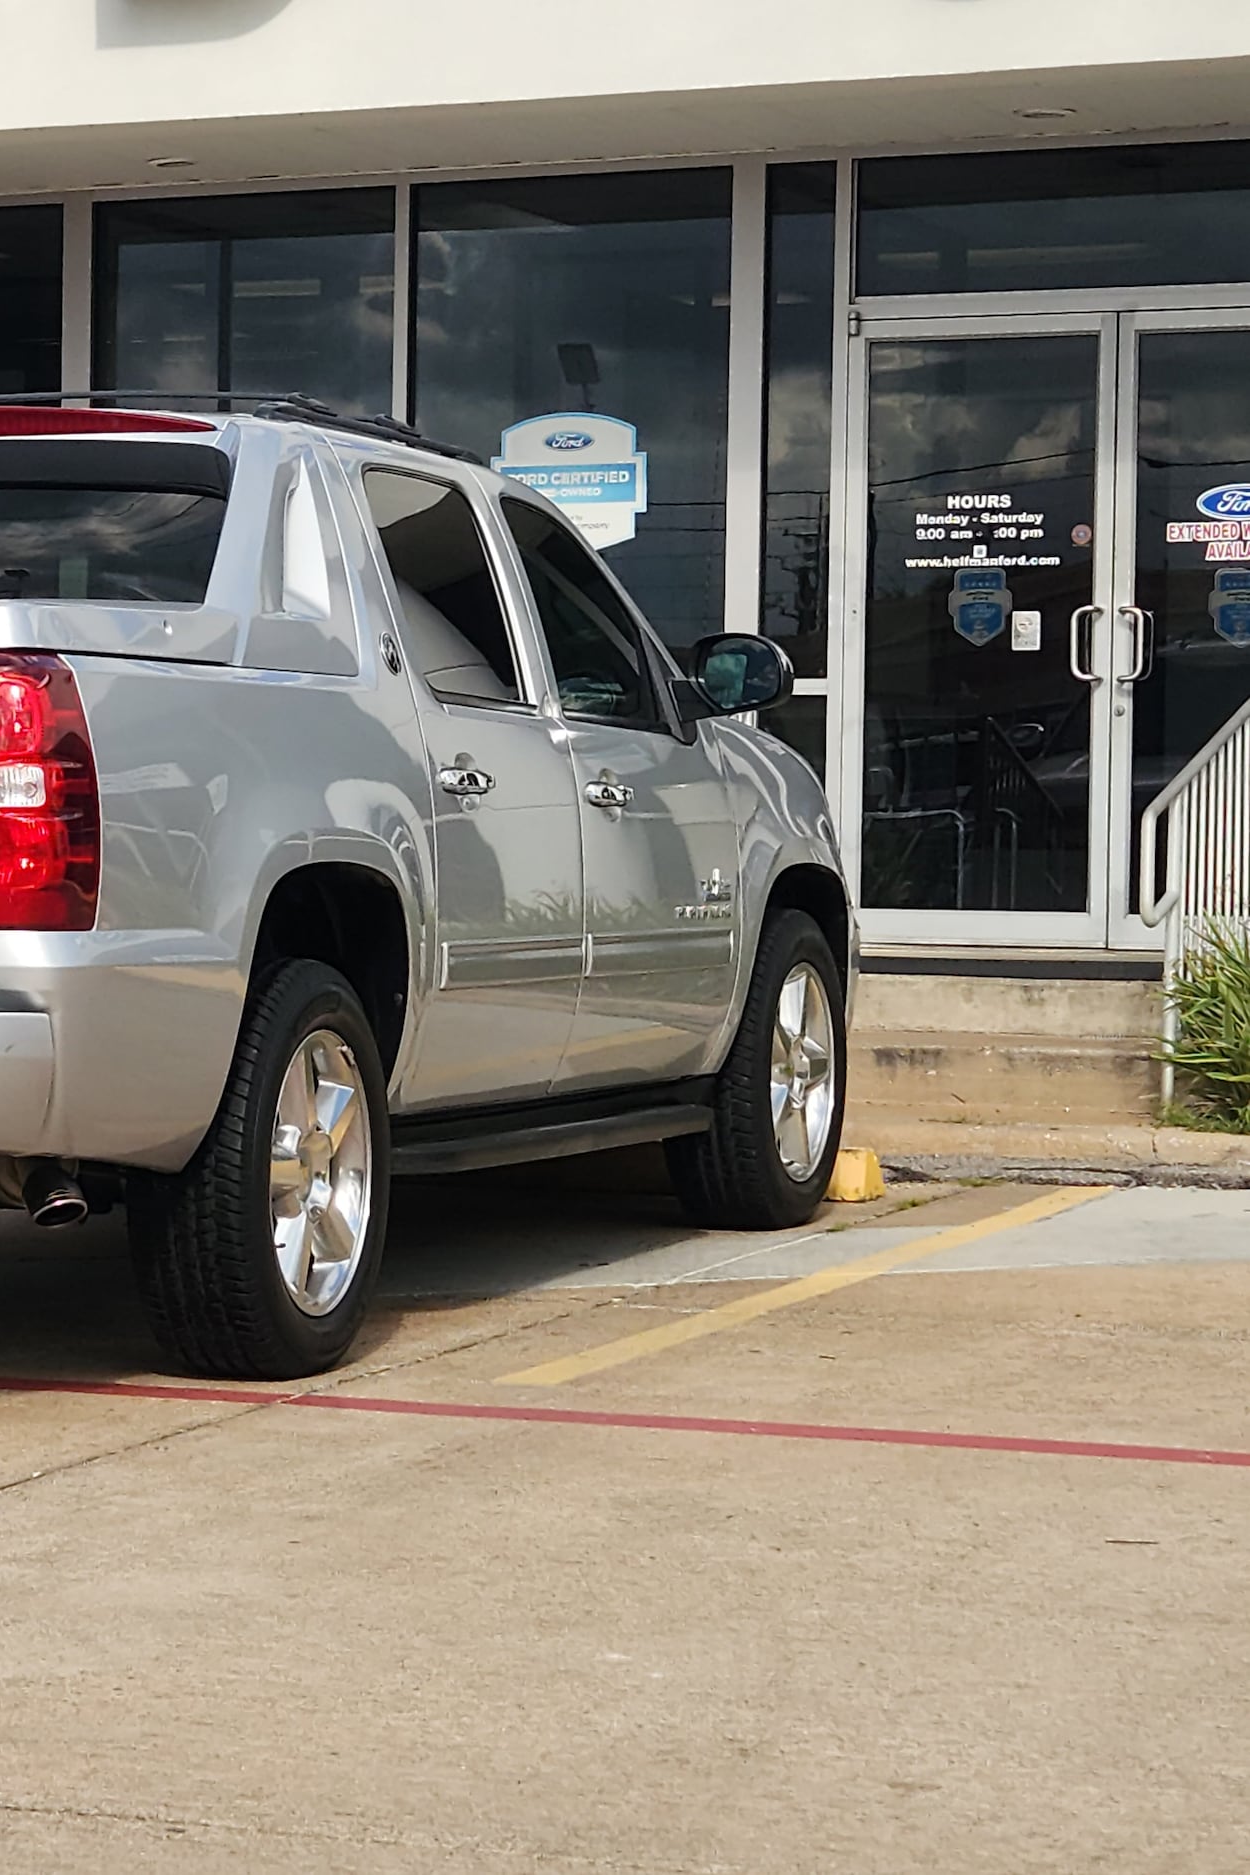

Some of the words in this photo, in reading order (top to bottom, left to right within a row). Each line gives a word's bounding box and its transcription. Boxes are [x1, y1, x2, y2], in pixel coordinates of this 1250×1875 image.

[552, 433, 584, 448] Ford
[551, 470, 631, 485] CERTIFIED
[947, 494, 1012, 509] HOURS
[915, 513, 970, 527] Monday
[980, 512, 1044, 525] Saturday
[950, 530, 973, 539] am
[1020, 529, 1044, 540] pm
[1168, 524, 1240, 540] EXTENDED
[905, 555, 1061, 568] www.helfmanford.com
